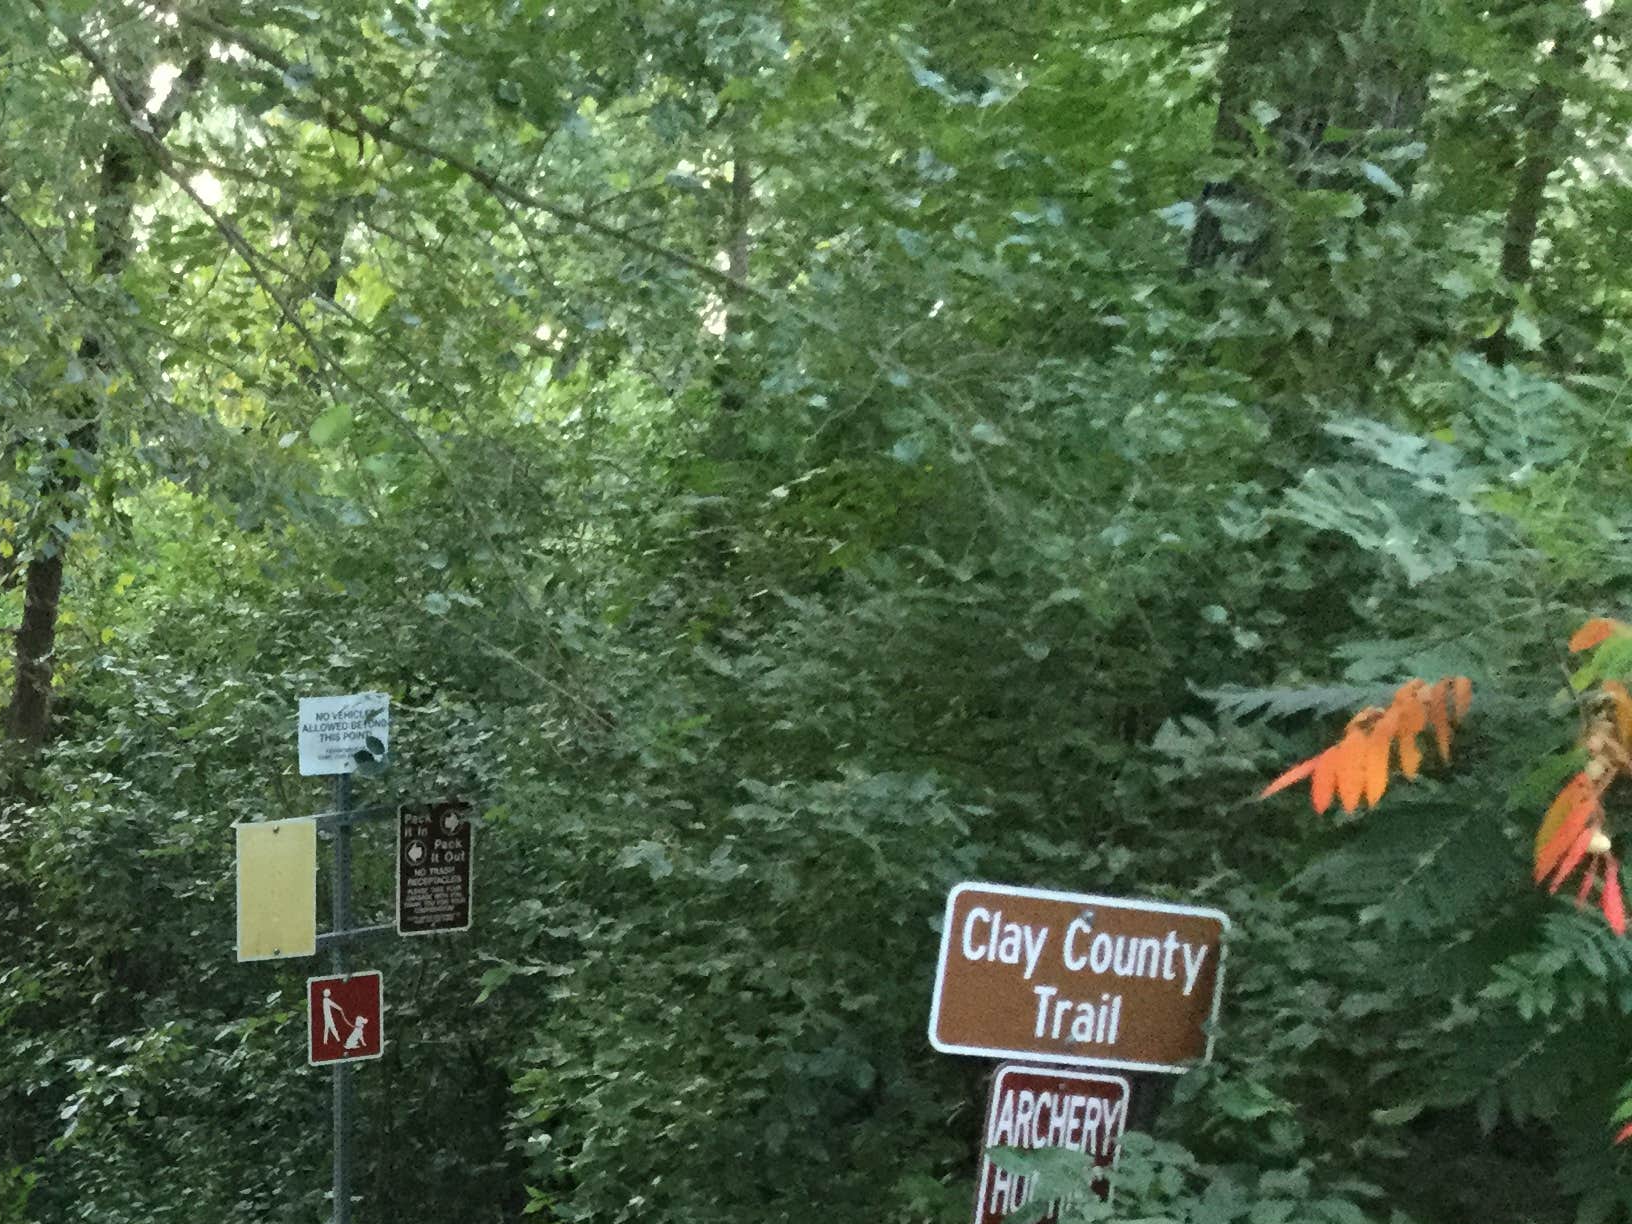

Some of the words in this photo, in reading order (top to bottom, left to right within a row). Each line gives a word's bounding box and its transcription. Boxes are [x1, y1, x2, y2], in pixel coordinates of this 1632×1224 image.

[316, 712, 330, 721] NO
[302, 721, 348, 733] ALLOWED
[320, 733, 341, 743] THIS
[434, 838, 463, 850] Pack
[444, 850, 465, 863] Out
[963, 906, 1049, 980] Clay
[1062, 917, 1209, 996] County
[1033, 985, 1123, 1045] Trail
[992, 1088, 1121, 1157] ARCHERY
